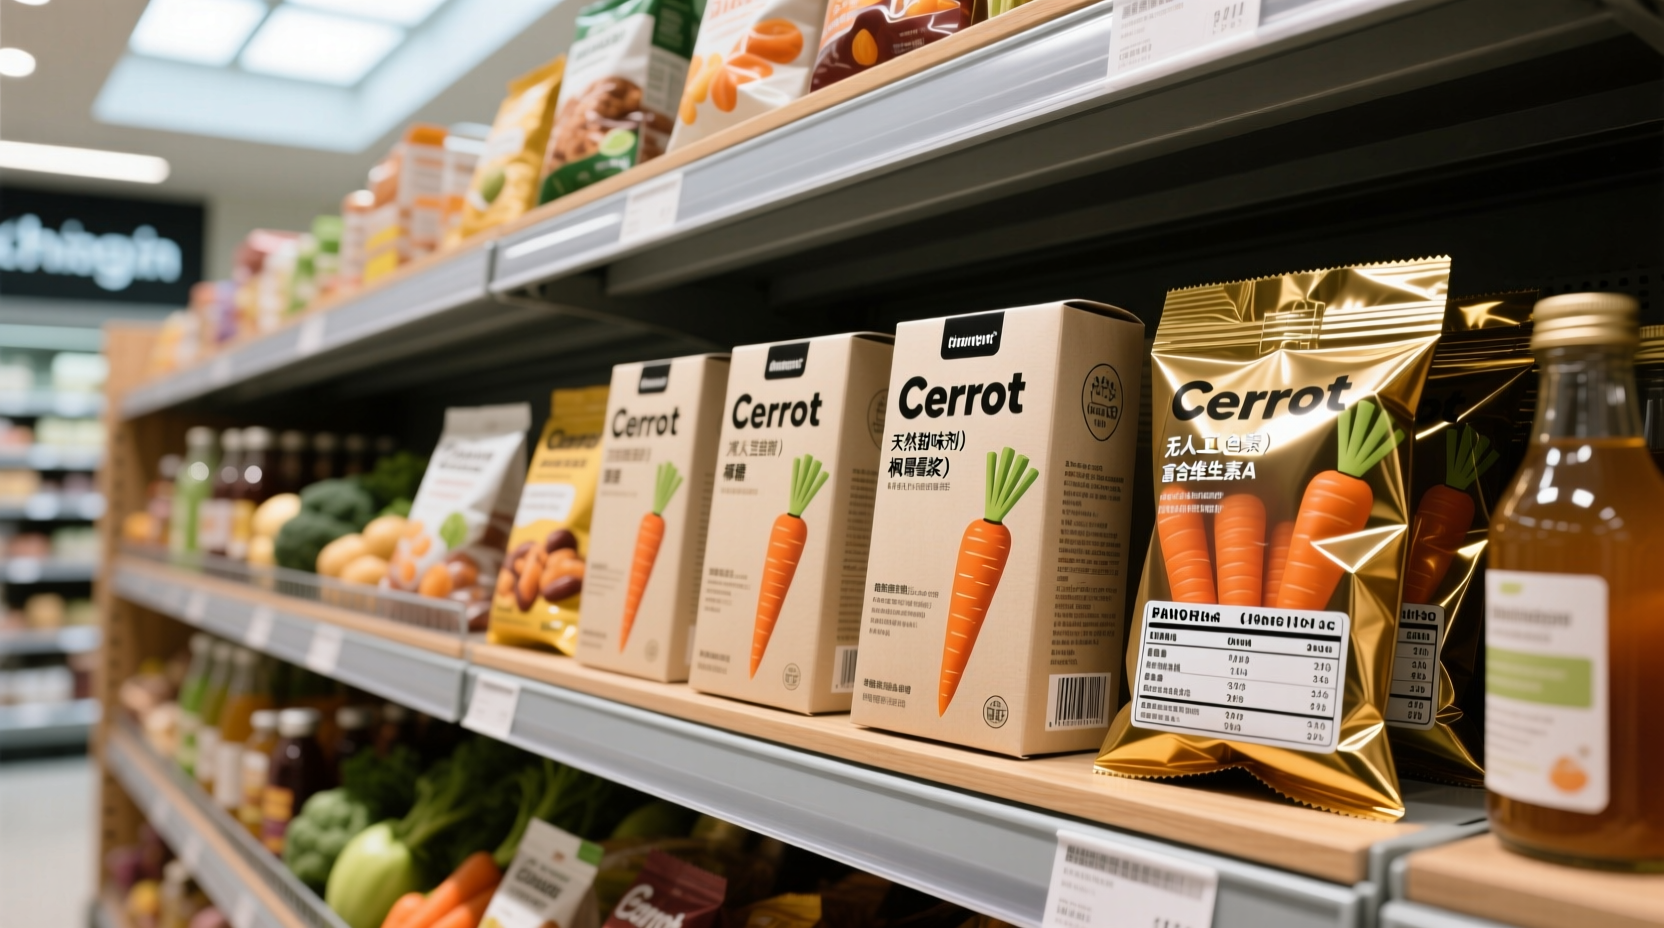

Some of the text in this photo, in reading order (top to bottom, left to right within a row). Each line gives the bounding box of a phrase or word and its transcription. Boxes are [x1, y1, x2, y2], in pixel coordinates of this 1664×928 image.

[733, 392, 823, 430] Cerrot
[898, 373, 1026, 420] Cerrot
[1172, 375, 1352, 421] Cerrot
[612, 407, 680, 439] Cerrot
